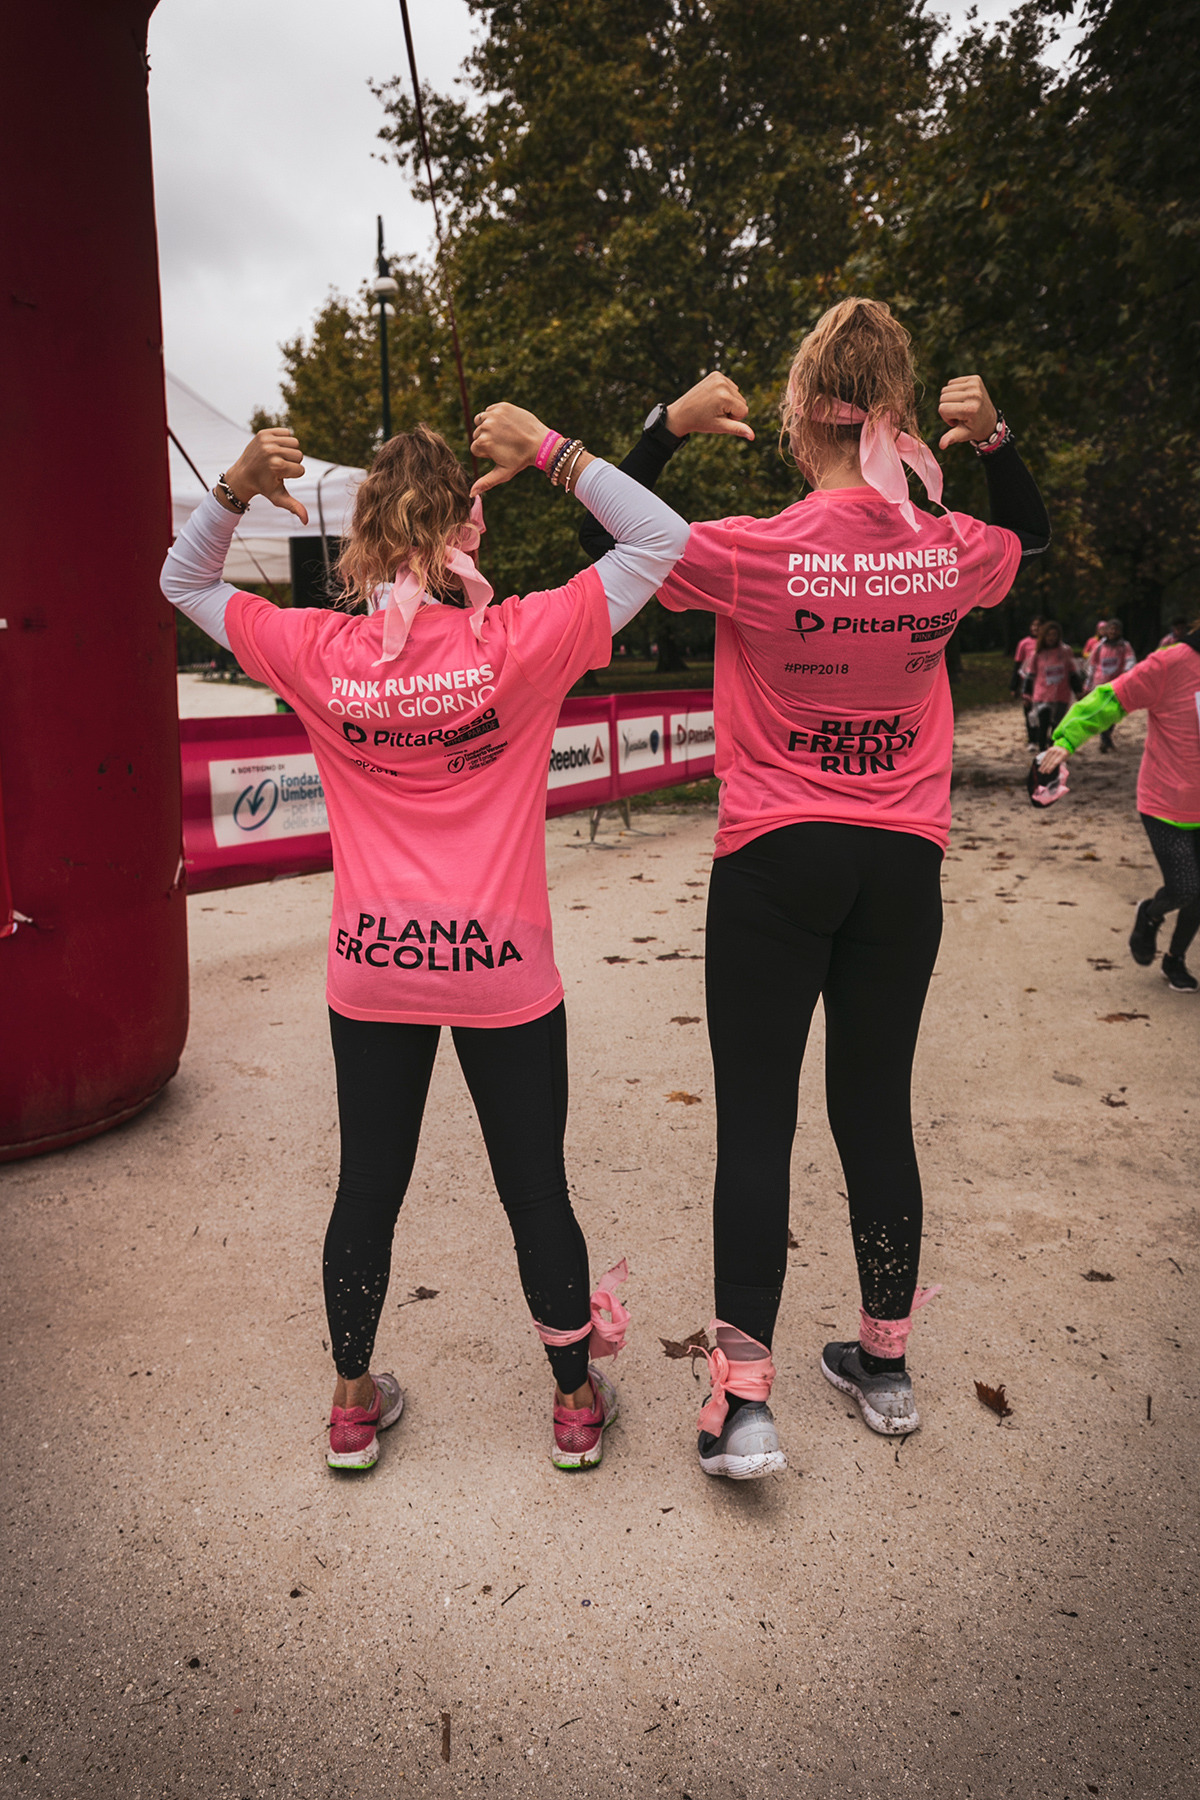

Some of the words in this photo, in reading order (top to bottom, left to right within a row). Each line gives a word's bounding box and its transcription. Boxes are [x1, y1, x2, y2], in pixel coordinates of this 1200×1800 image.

[787, 553, 848, 573] PINK
[853, 547, 958, 572] RUNNERS
[786, 575, 857, 597] OGNI
[864, 567, 960, 597] GIORNO
[832, 608, 958, 634] PittaRosso
[914, 633, 932, 641] PINK
[331, 676, 380, 698] PINK
[384, 663, 495, 697] RUNNERS
[784, 662, 849, 675] #PPP2018
[327, 698, 391, 719] OGNI
[397, 684, 496, 718] GIORNO
[373, 707, 496, 747] PittaRosso
[467, 720, 497, 737] PARADE
[820, 714, 901, 736] RUN
[787, 725, 921, 755] FREDDY
[549, 743, 591, 772] Reebok
[820, 754, 897, 776] RUN
[280, 772, 321, 788] Fondaz
[356, 912, 489, 945] PLANA
[335, 928, 524, 972] ERCOLINA
